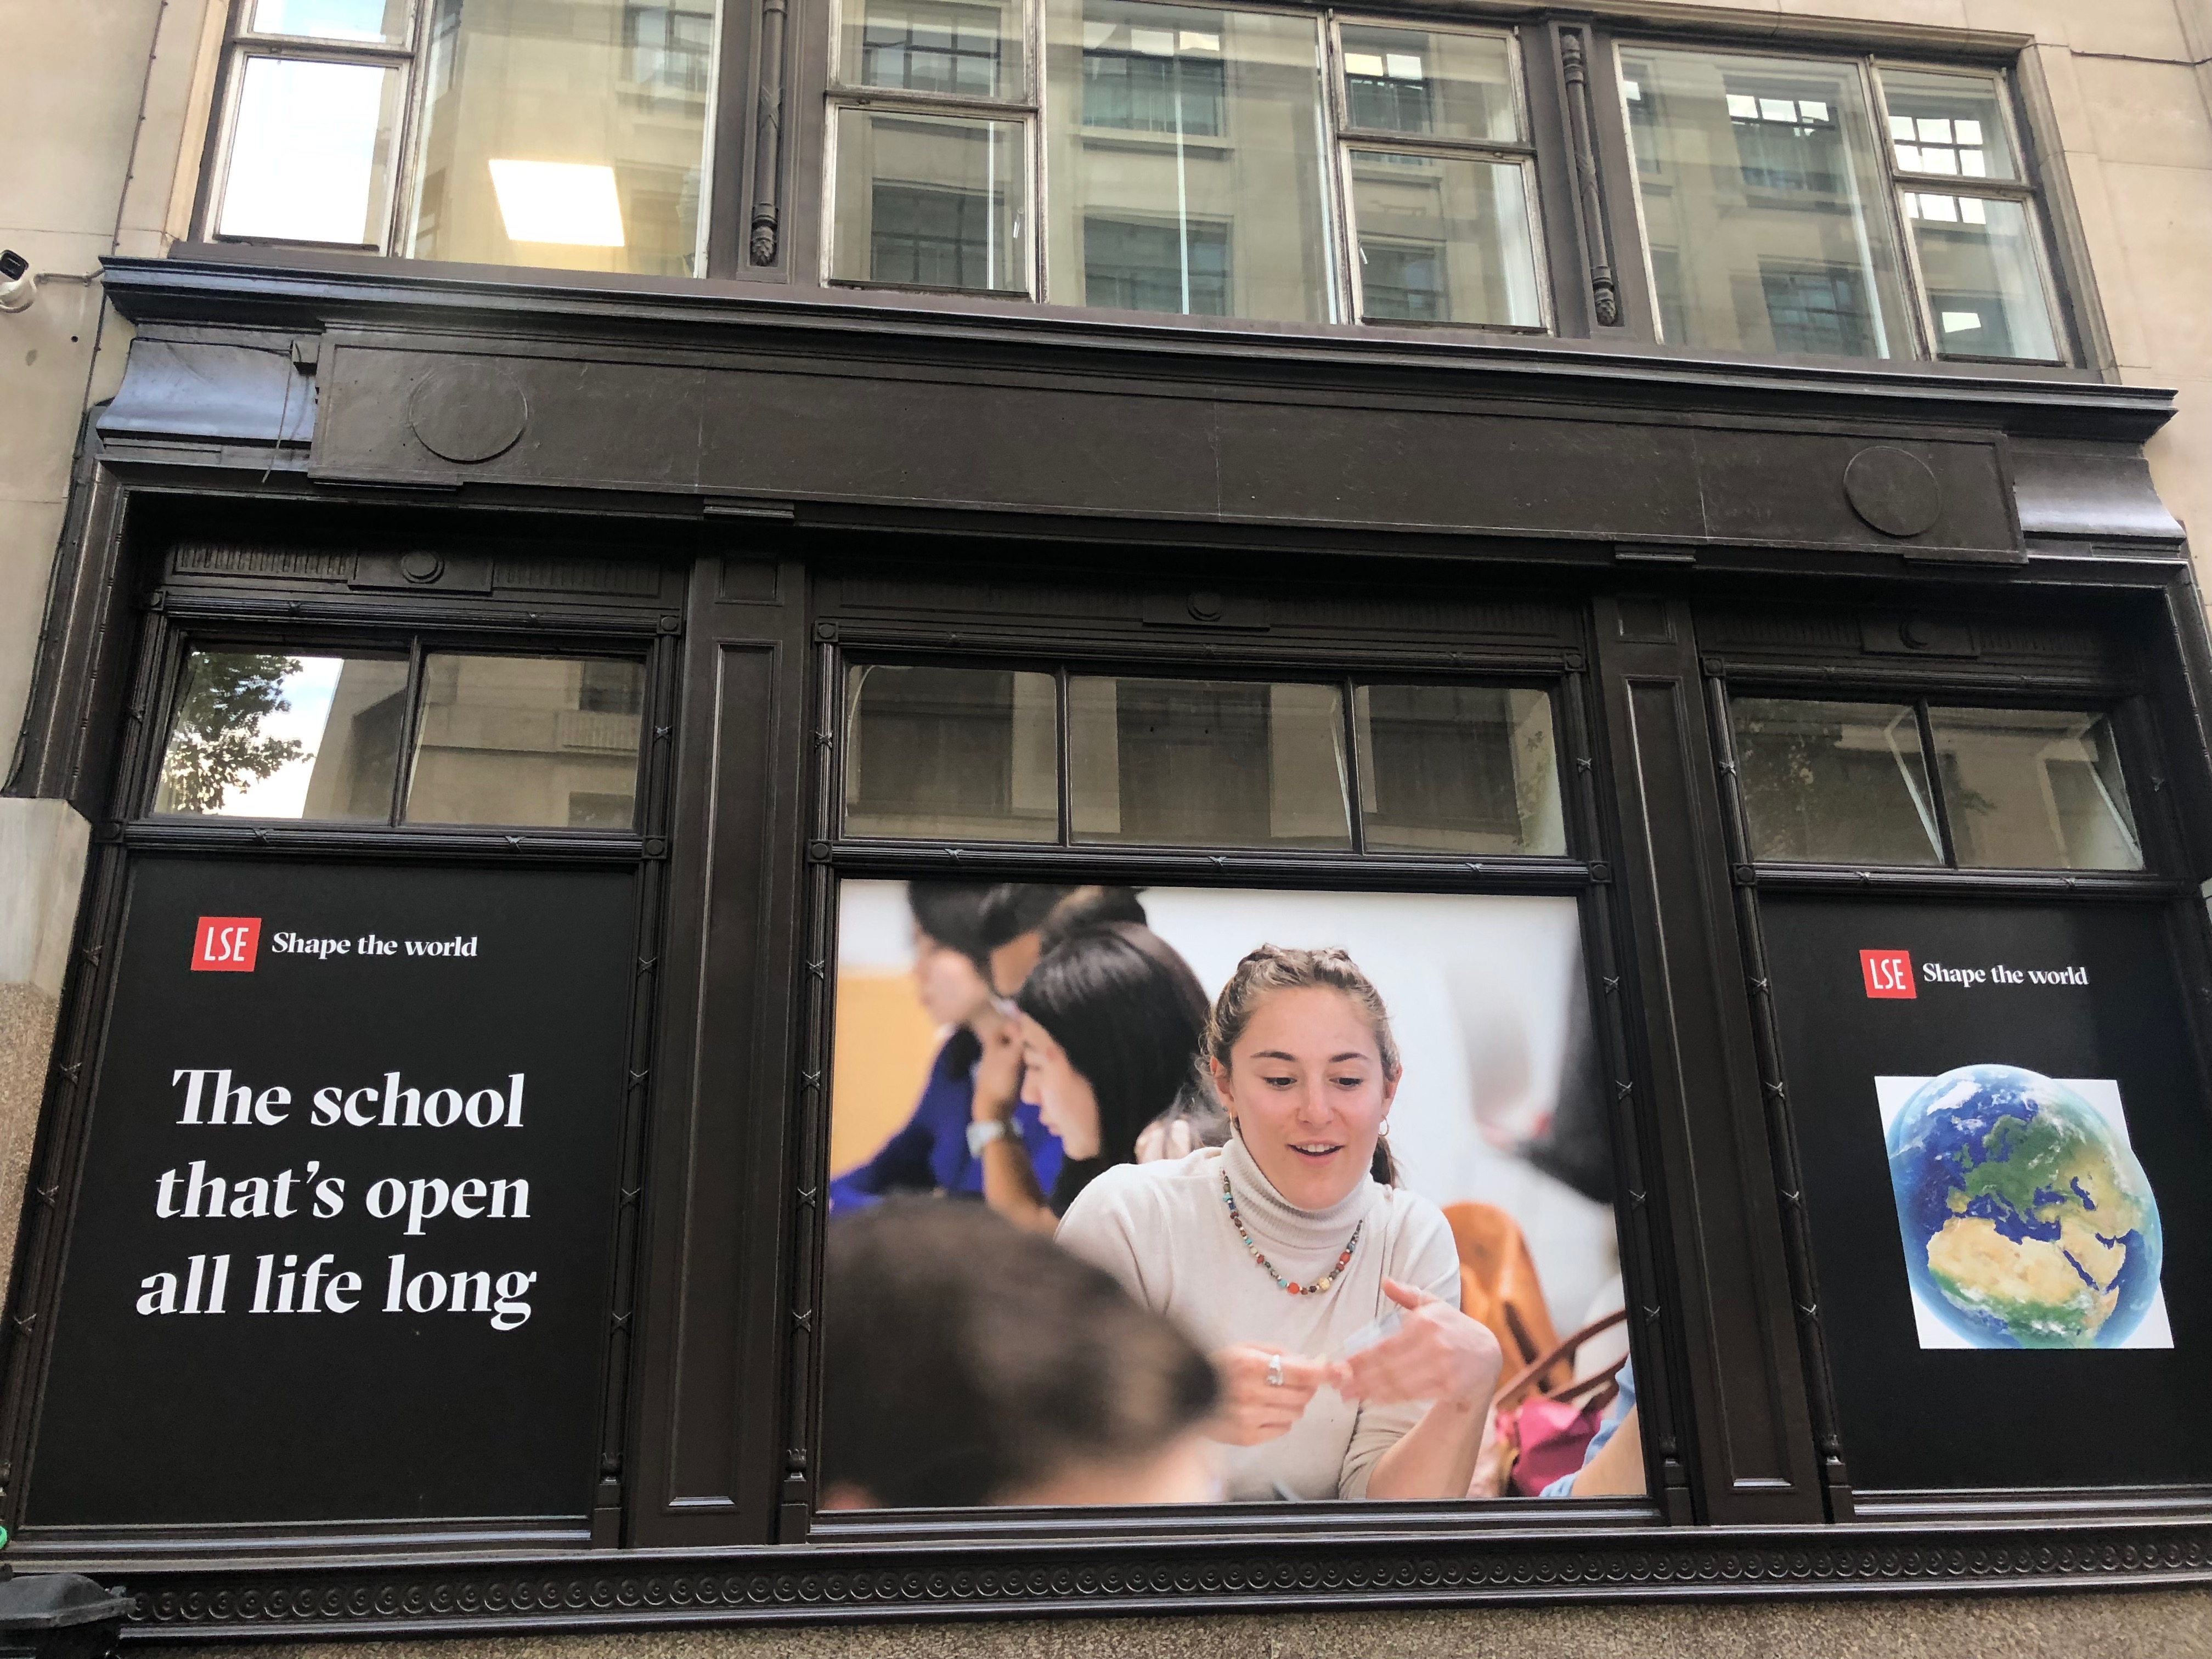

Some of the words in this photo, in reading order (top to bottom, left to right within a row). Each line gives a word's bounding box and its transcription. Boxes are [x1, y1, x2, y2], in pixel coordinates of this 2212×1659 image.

[203, 926, 250, 962] LSE
[271, 931, 352, 960] Shape
[357, 934, 399, 956] the
[403, 936, 478, 957] world
[1869, 958, 1908, 990] LSE
[1922, 963, 1987, 988] Shape
[1989, 964, 2024, 984] the
[2027, 966, 2090, 985] world
[172, 1069, 291, 1126] The
[309, 1071, 525, 1128] school
[155, 1160, 345, 1218] that’s
[366, 1178, 531, 1235] open
[136, 1254, 230, 1316] all
[248, 1254, 362, 1313] life
[382, 1254, 537, 1331] long
